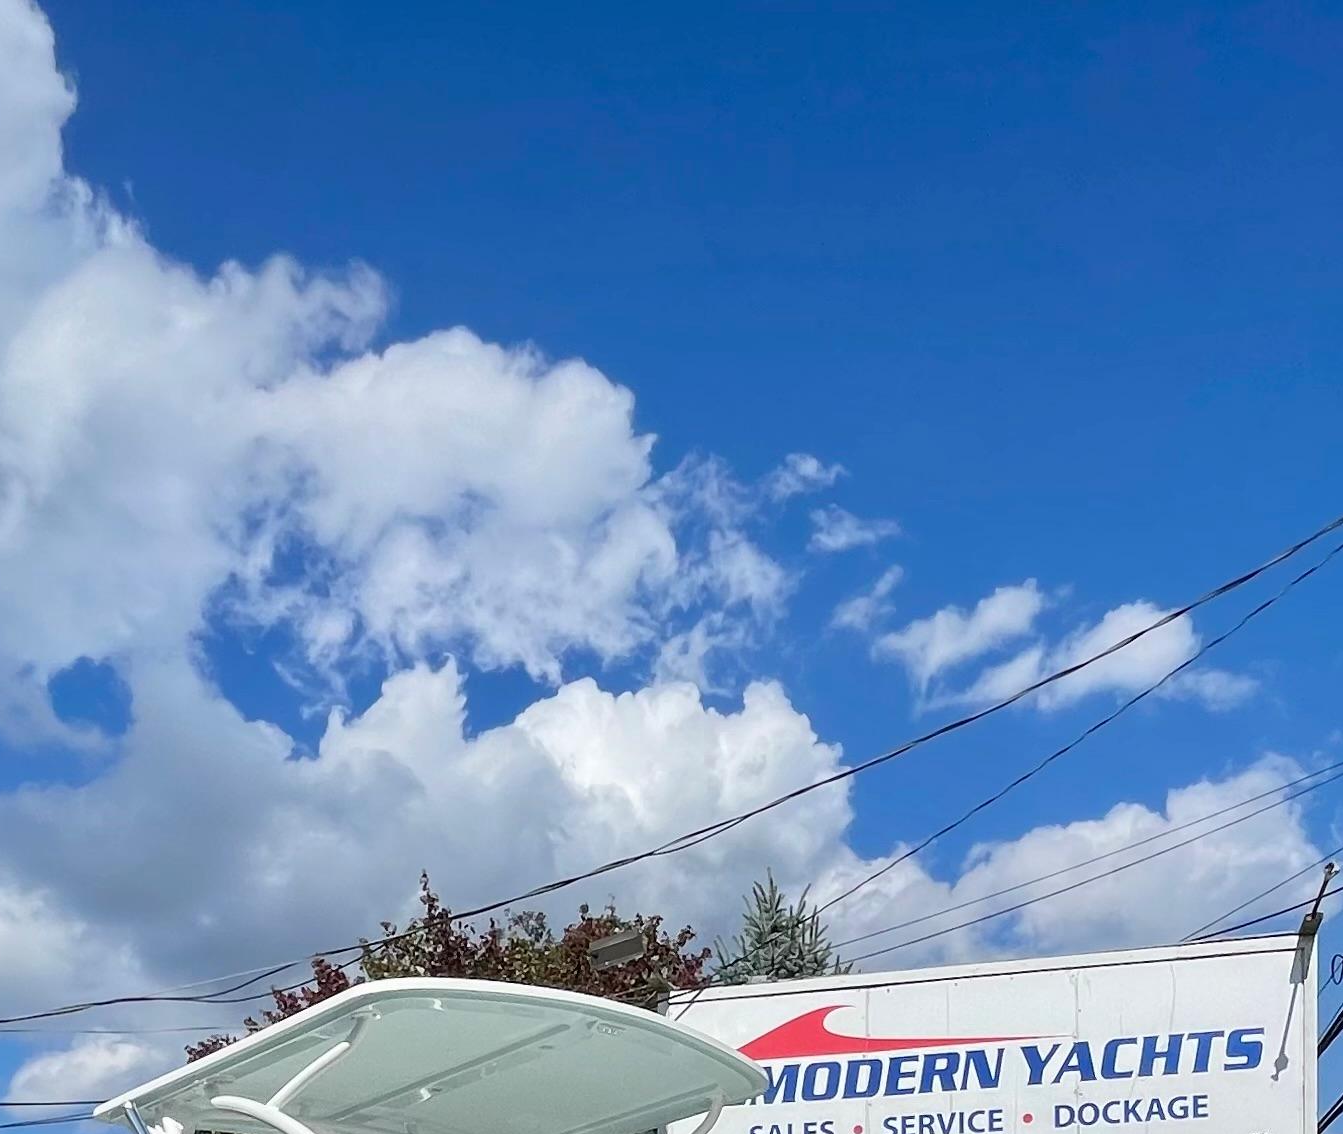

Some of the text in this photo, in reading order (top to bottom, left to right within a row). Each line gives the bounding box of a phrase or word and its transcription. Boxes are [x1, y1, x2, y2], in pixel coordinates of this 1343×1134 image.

[745, 1027, 1265, 1105] MODERN YACHTS
[1054, 1094, 1209, 1128] DOCKAGE
